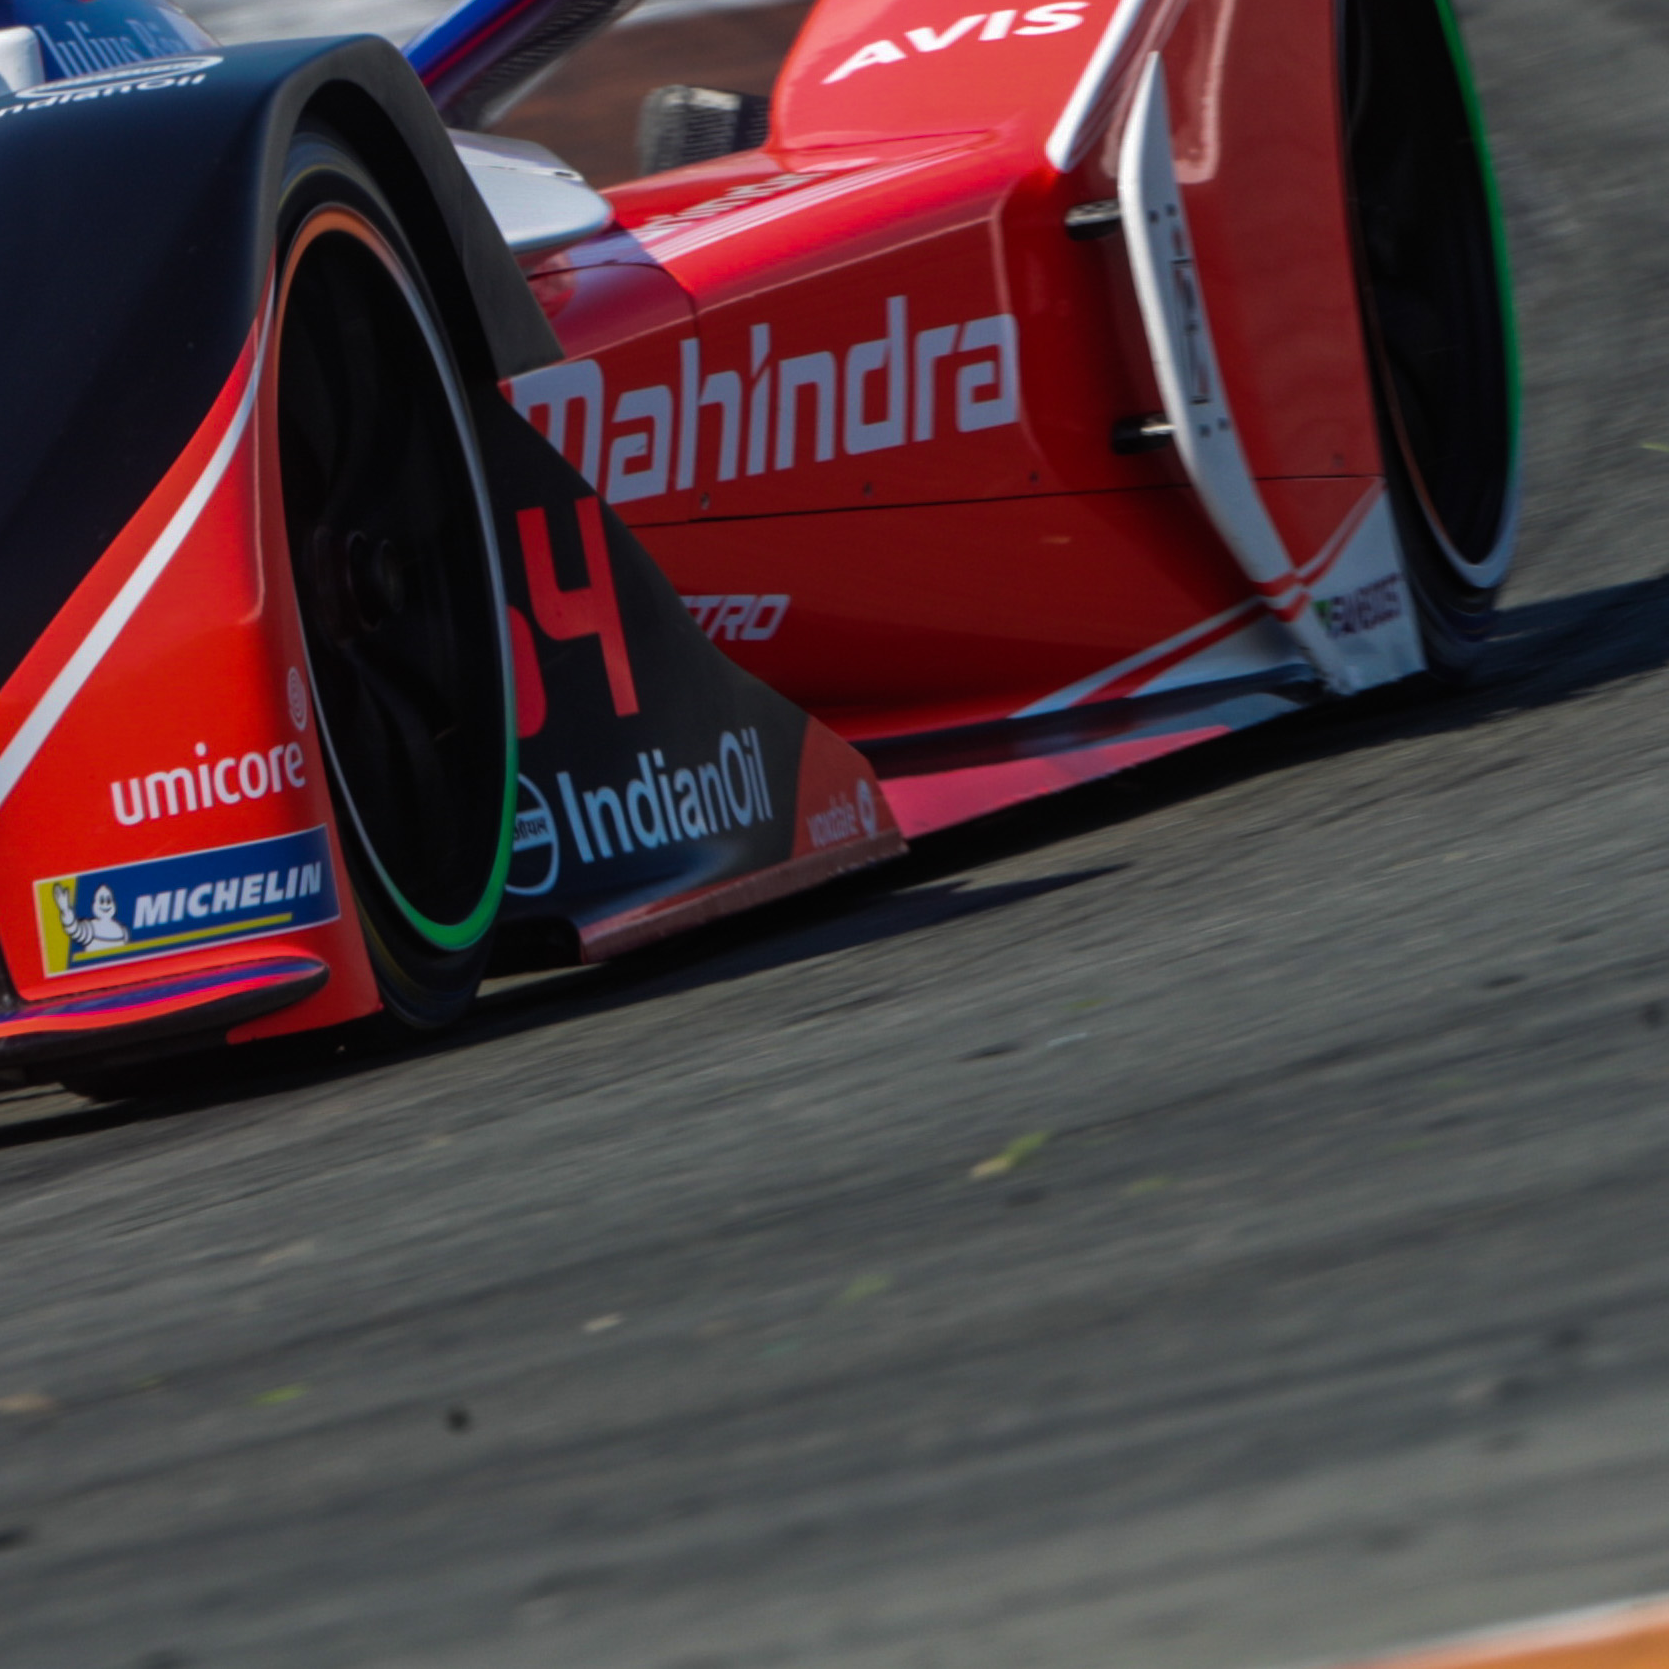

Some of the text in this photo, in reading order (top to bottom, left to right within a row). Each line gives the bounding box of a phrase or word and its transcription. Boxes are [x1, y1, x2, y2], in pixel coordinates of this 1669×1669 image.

[822, 0, 1090, 84] AVIS
[510, 294, 1019, 505] Mahindra
[680, 593, 791, 641] TRO
[109, 741, 307, 827] umicore
[555, 727, 774, 864] IndianOil
[133, 861, 322, 931] MICHELIN
